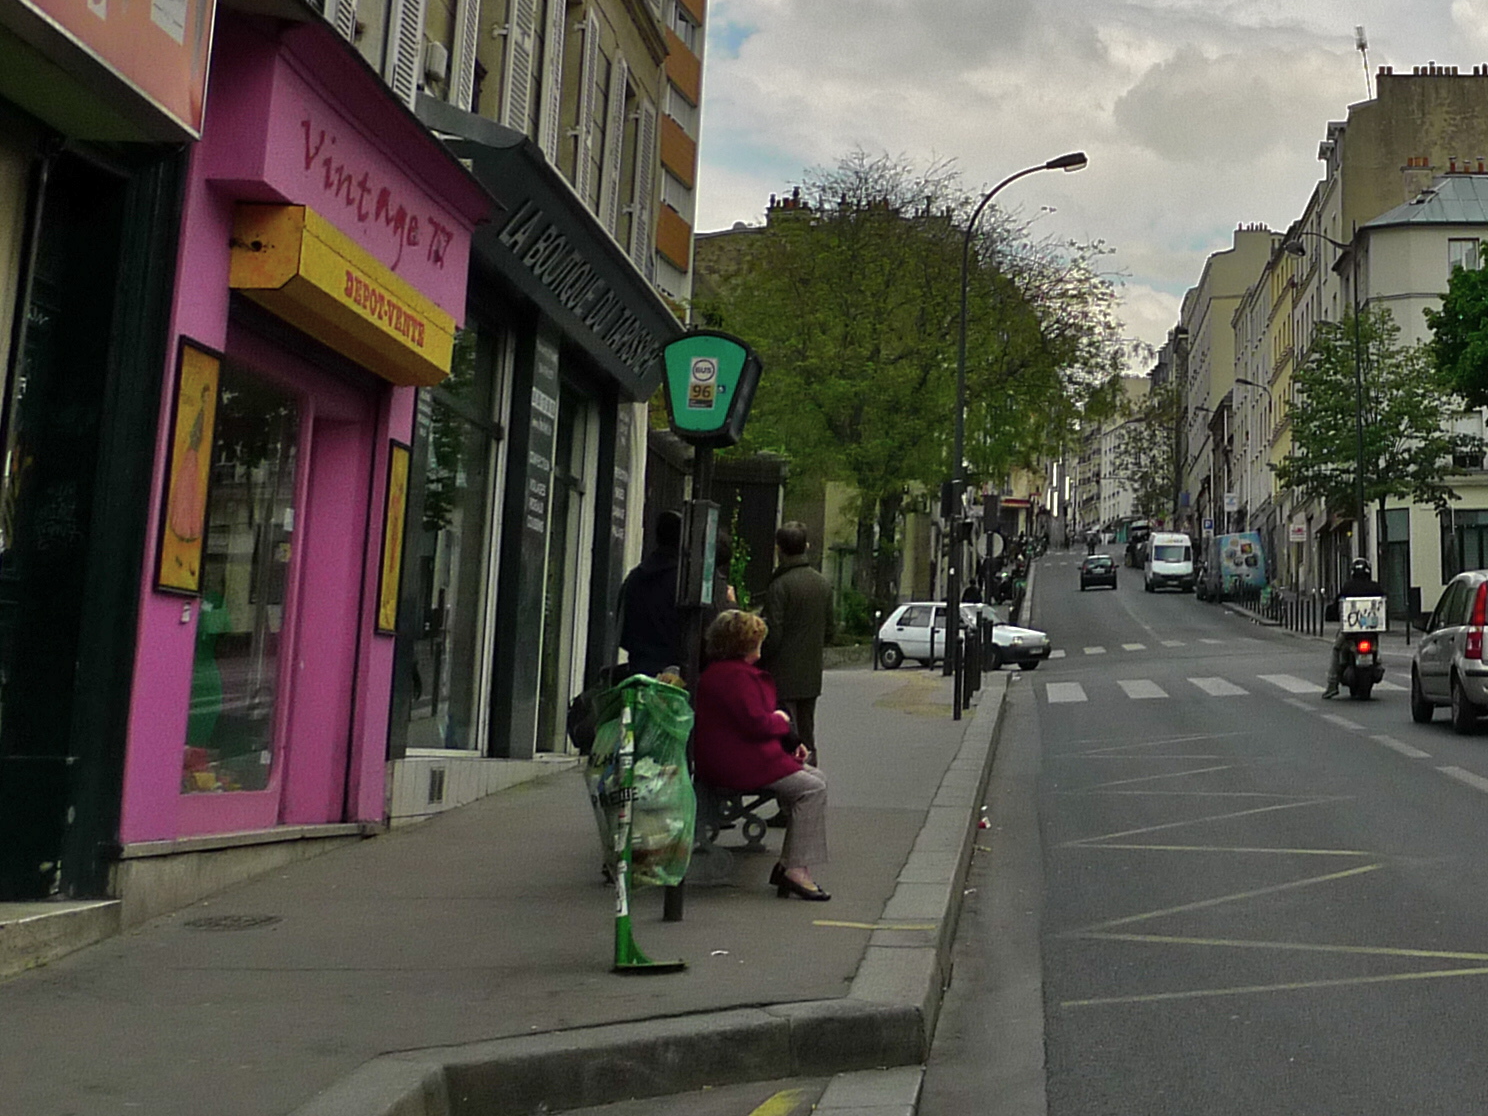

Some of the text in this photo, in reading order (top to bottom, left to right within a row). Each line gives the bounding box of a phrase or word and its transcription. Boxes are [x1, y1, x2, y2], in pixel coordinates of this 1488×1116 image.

[301, 119, 419, 272] Vintage
[498, 200, 543, 254] LA
[522, 224, 606, 316] BOUTIQUE
[584, 288, 621, 333] DU
[344, 269, 425, 348] DEPOT-VENTE
[692, 384, 712, 398] 96
[694, 366, 712, 374] BUS
